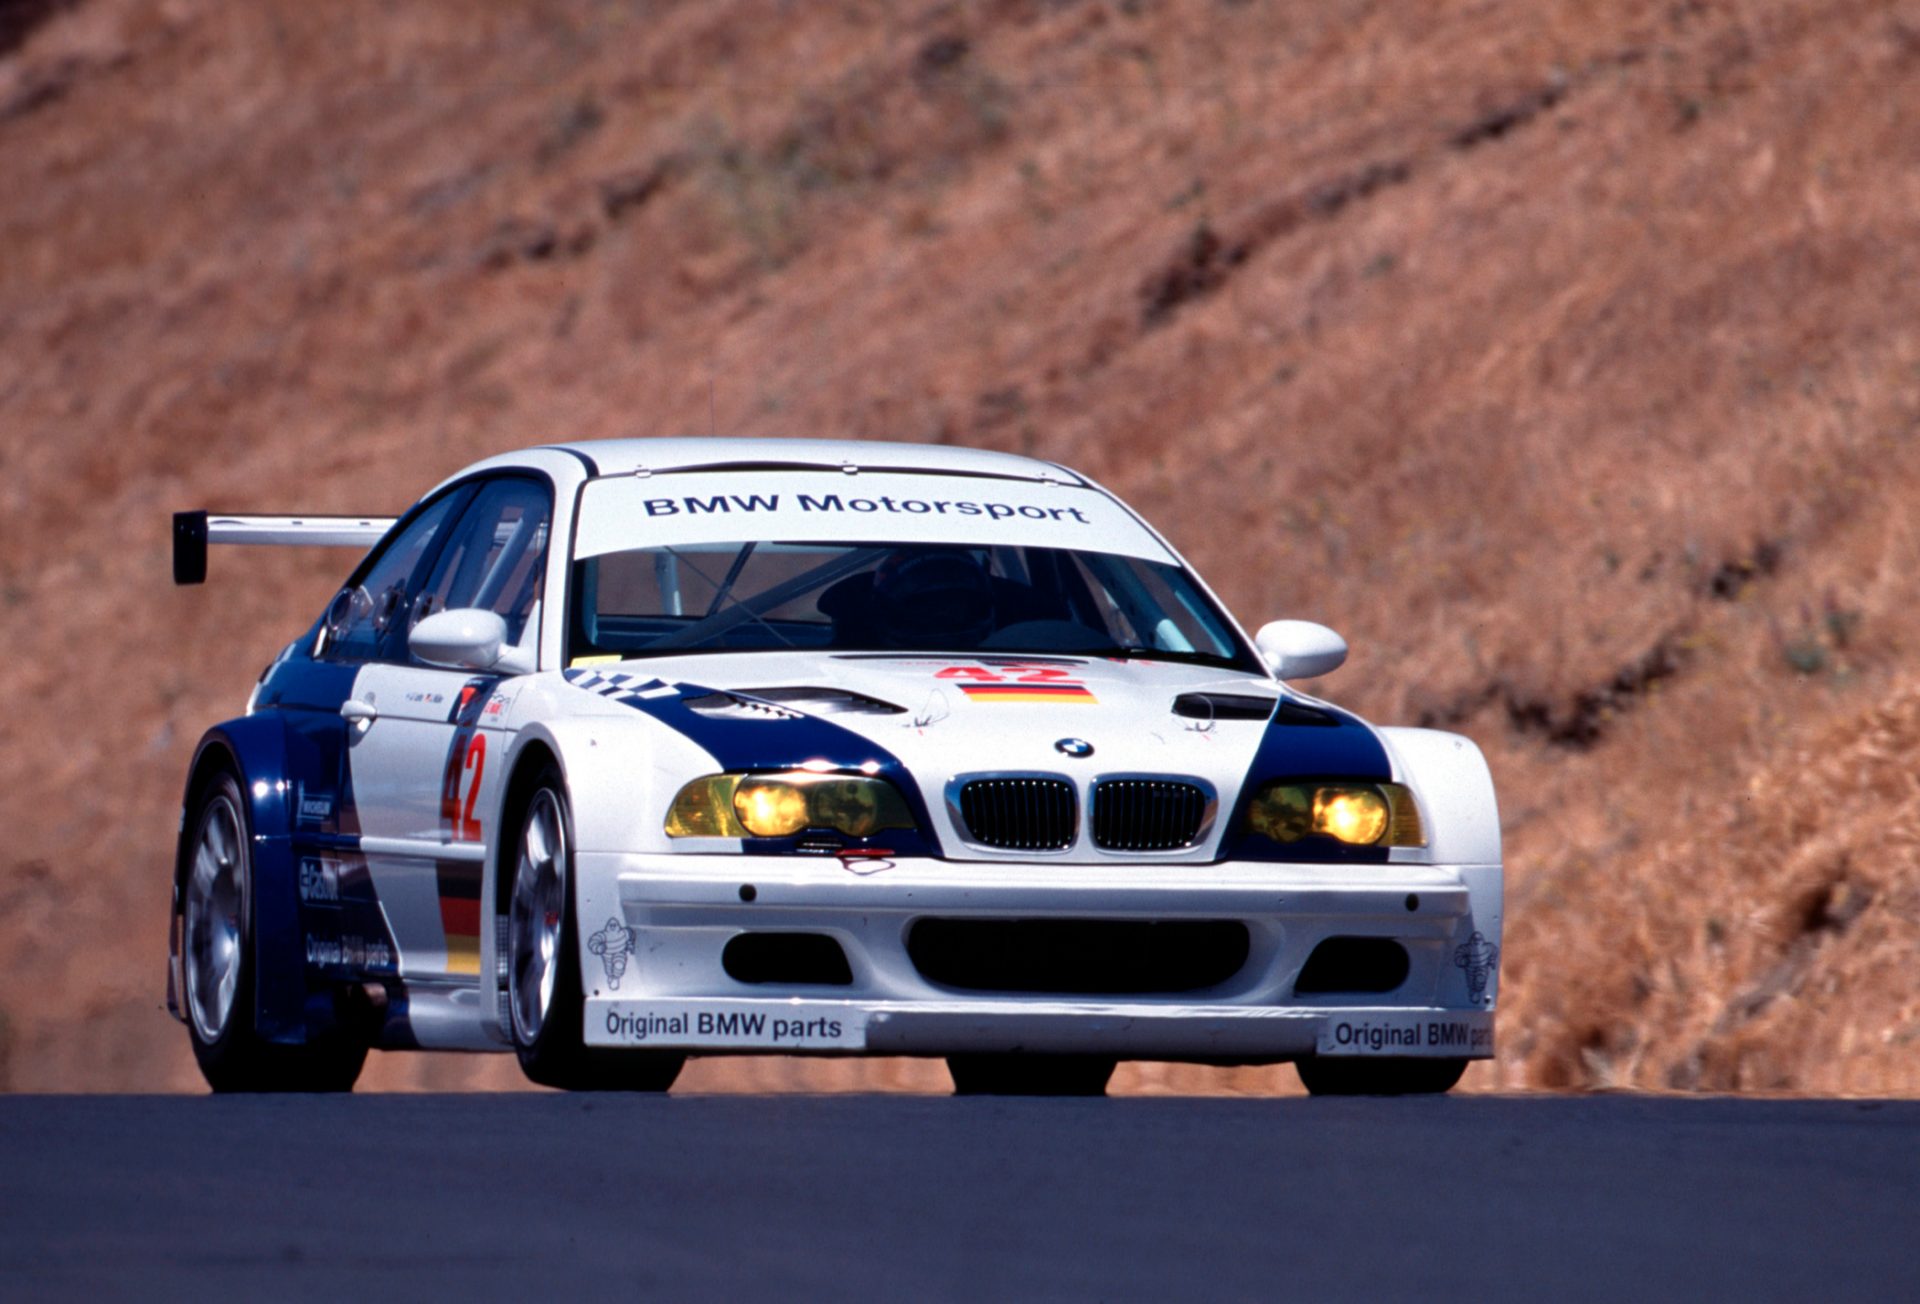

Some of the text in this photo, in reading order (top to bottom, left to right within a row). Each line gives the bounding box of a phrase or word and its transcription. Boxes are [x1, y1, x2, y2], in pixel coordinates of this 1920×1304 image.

[644, 494, 1090, 524] BMW Motorsport
[934, 667, 1086, 684] 42
[441, 733, 486, 842] 42
[606, 1012, 842, 1040] Original BMW parts
[1335, 1023, 1420, 1050] Original
[1428, 1023, 1469, 1045] BMW
